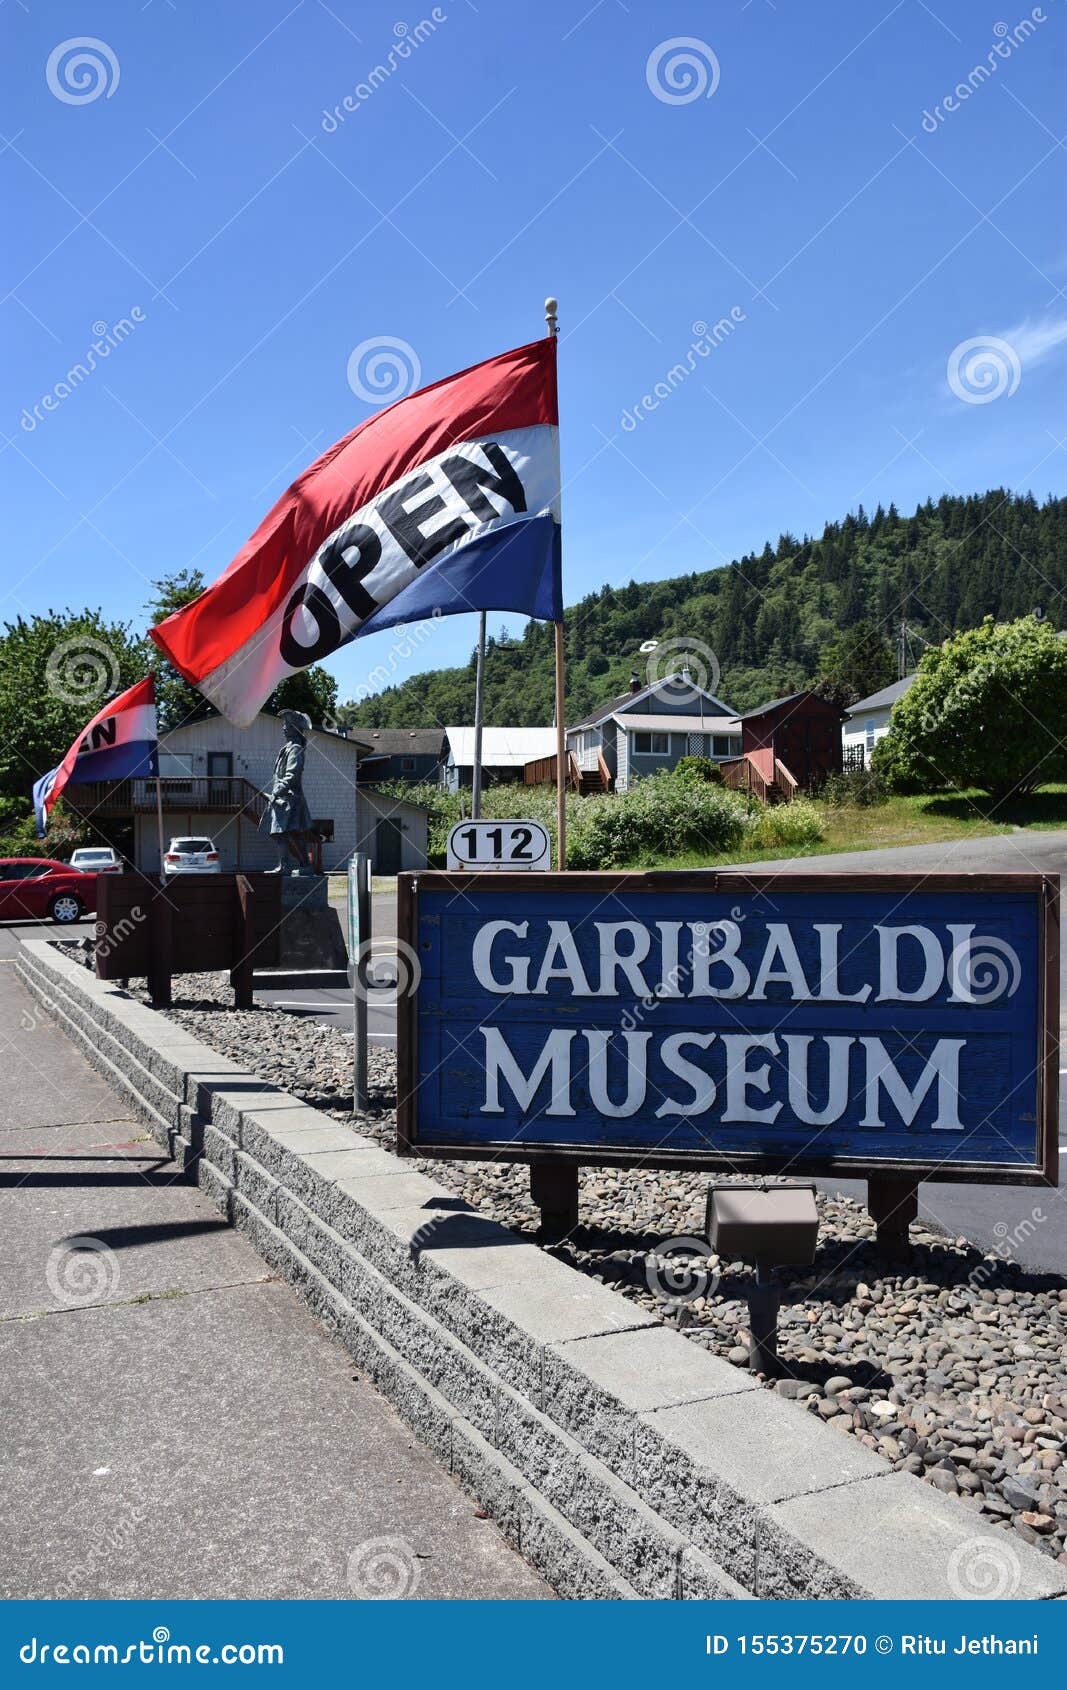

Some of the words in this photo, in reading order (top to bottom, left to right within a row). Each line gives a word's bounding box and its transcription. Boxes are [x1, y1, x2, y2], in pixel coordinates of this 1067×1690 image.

[280, 442, 527, 667] OPEN
[461, 827, 532, 858] 112
[472, 919, 977, 1003] GARIBALDI
[479, 1026, 967, 1130] MUSEUM
